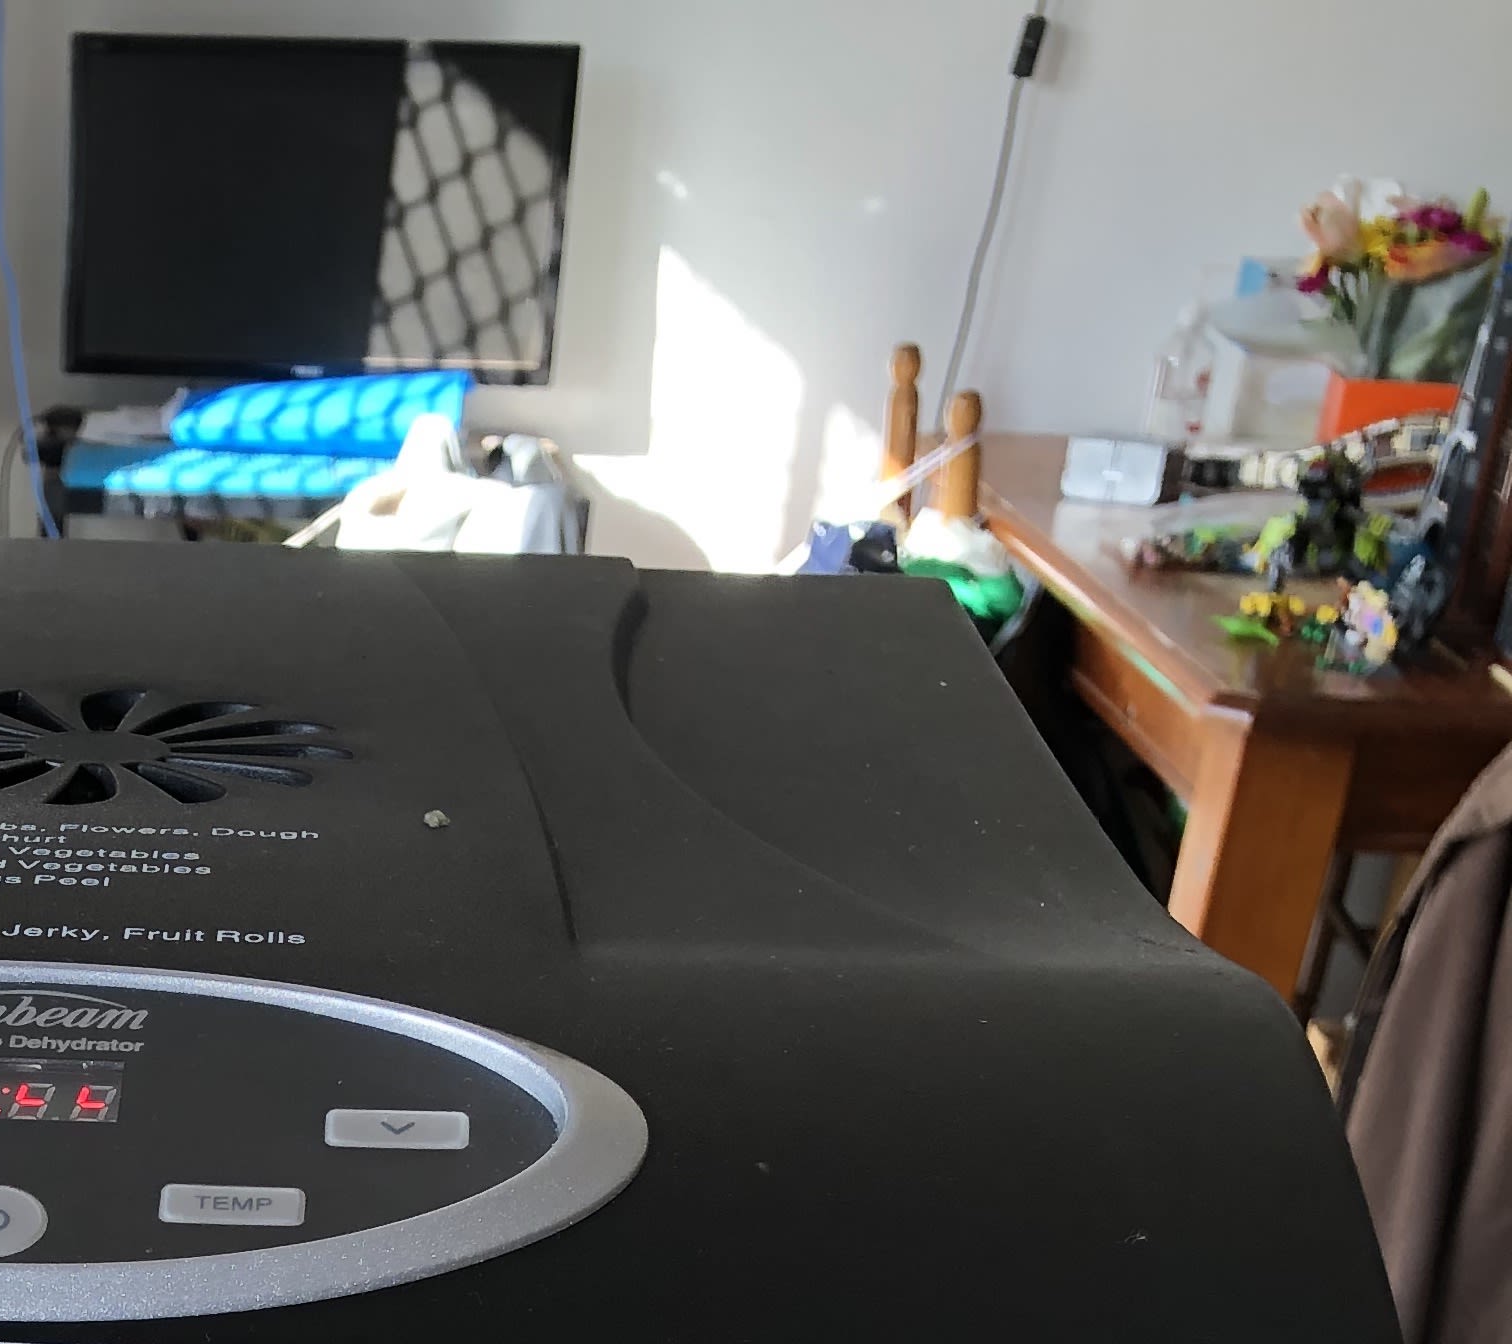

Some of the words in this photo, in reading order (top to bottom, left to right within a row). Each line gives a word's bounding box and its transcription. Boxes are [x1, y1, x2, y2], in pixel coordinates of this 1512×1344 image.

[211, 827, 320, 839] Dough
[8, 846, 200, 860] Vegetables
[18, 859, 211, 874] Vegetables
[34, 874, 110, 887] Peel
[1, 923, 110, 941] Jerky,
[123, 927, 205, 942] Fruit
[216, 930, 306, 944] Rolls
[9, 1035, 145, 1053] Dehydrator
[194, 1195, 273, 1211] TEMP
